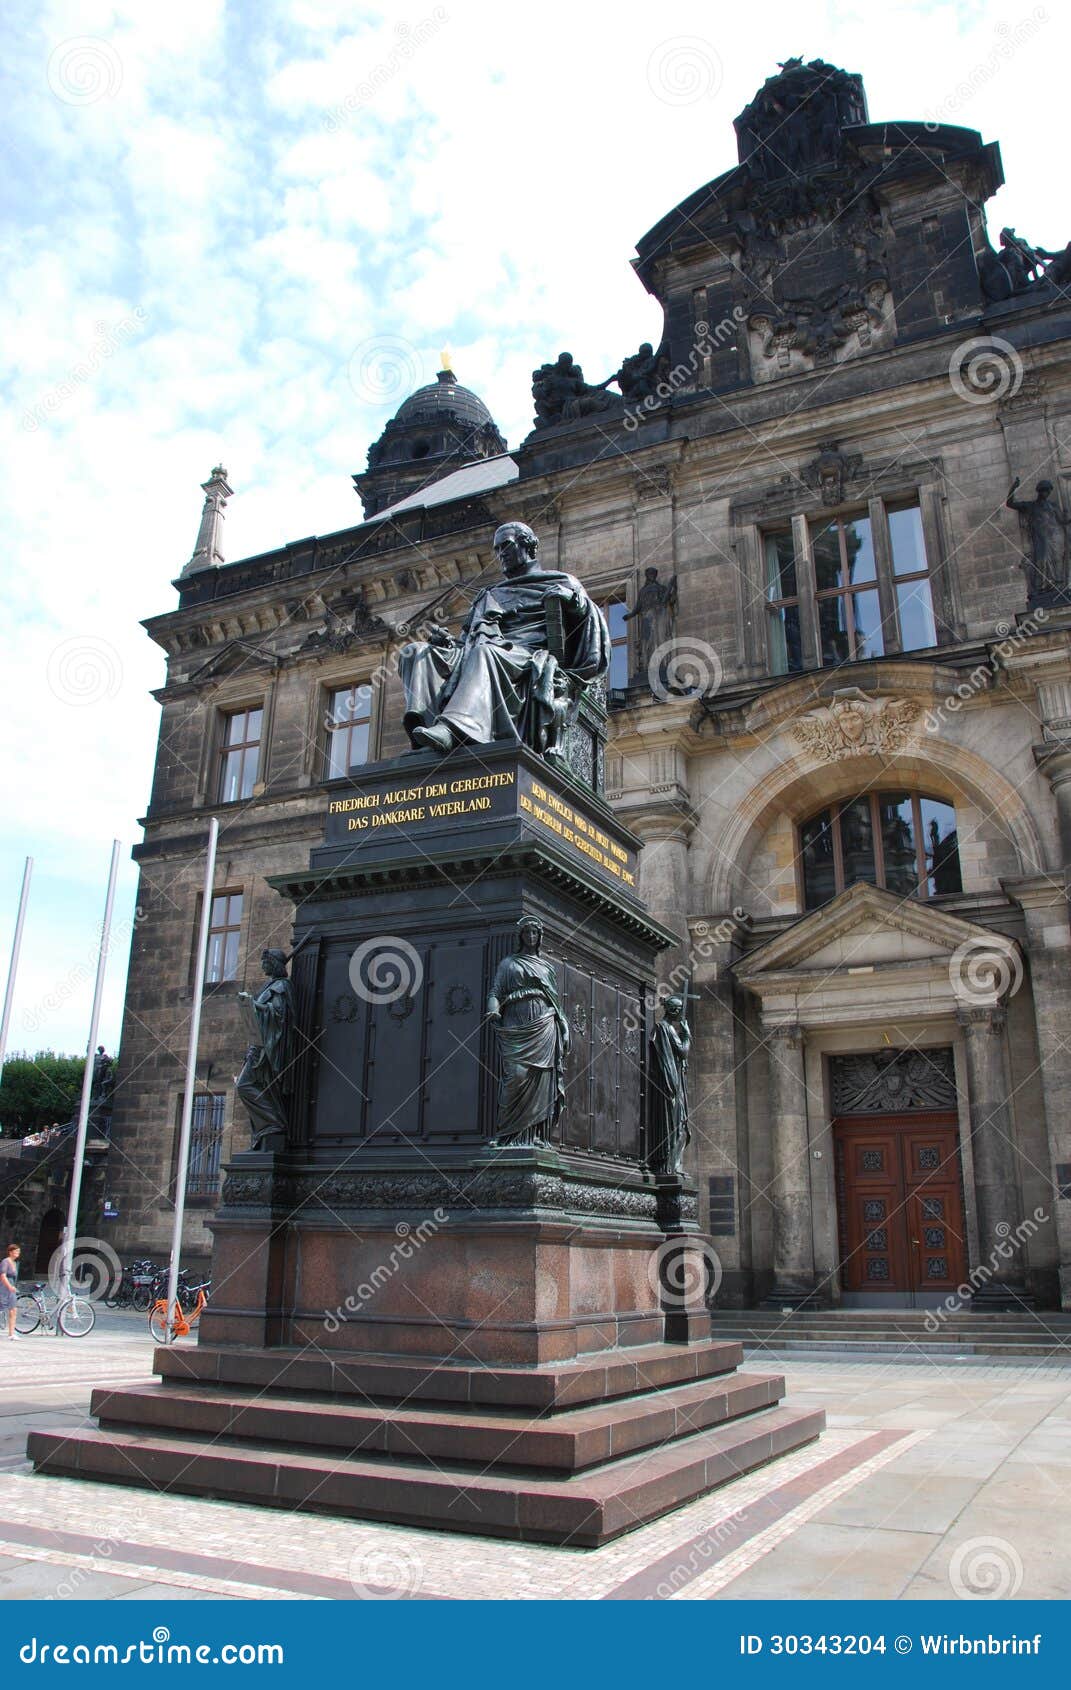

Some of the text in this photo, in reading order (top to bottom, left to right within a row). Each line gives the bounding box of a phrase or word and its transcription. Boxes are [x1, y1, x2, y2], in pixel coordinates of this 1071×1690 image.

[329, 771, 515, 814] FRIEDRICH AUGUST DEM GERECHTEN
[348, 796, 493, 831] DAS DANKBARE VATERLAND.
